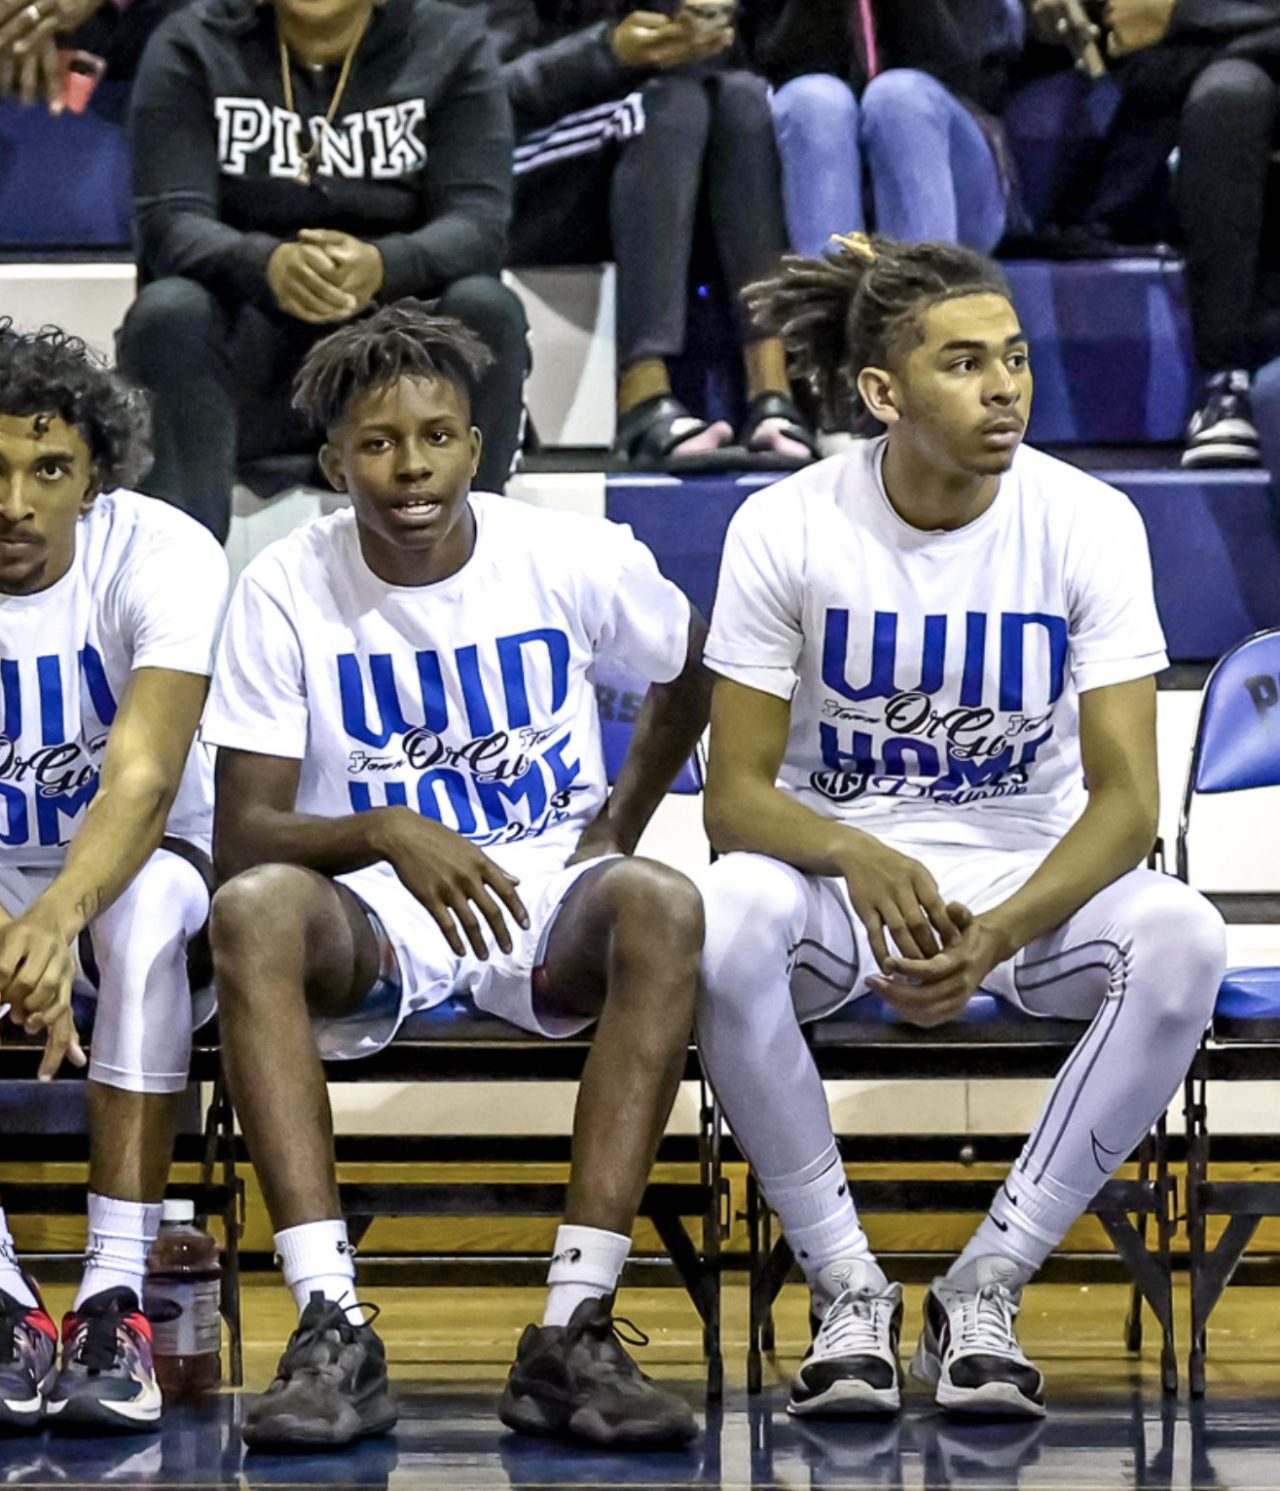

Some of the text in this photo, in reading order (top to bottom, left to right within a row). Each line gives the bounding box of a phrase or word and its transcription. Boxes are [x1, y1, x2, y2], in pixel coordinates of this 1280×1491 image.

[214, 97, 427, 179] PINK
[337, 627, 571, 749] WIN
[822, 607, 1068, 712] WIN
